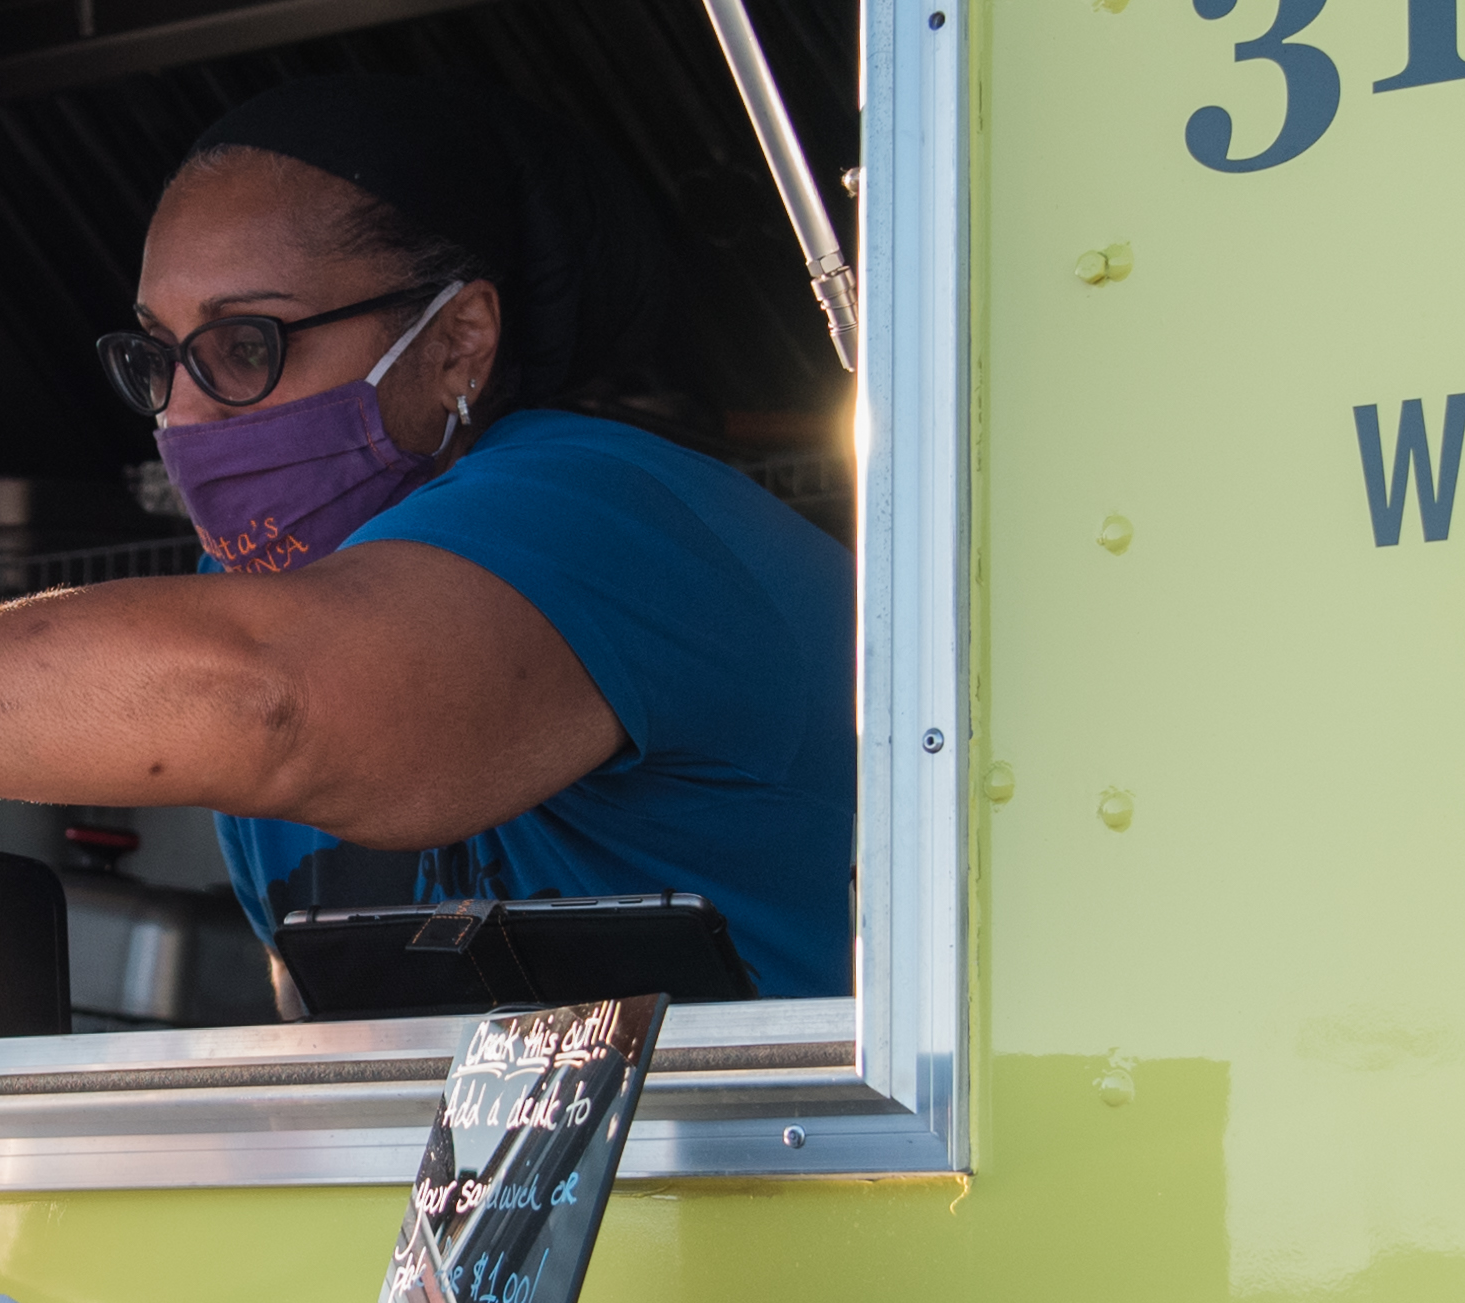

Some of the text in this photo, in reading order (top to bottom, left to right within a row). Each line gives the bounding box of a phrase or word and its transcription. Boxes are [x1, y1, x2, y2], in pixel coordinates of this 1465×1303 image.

[523, 1015, 559, 1058] this
[443, 1078, 591, 1130] Add a drink to
